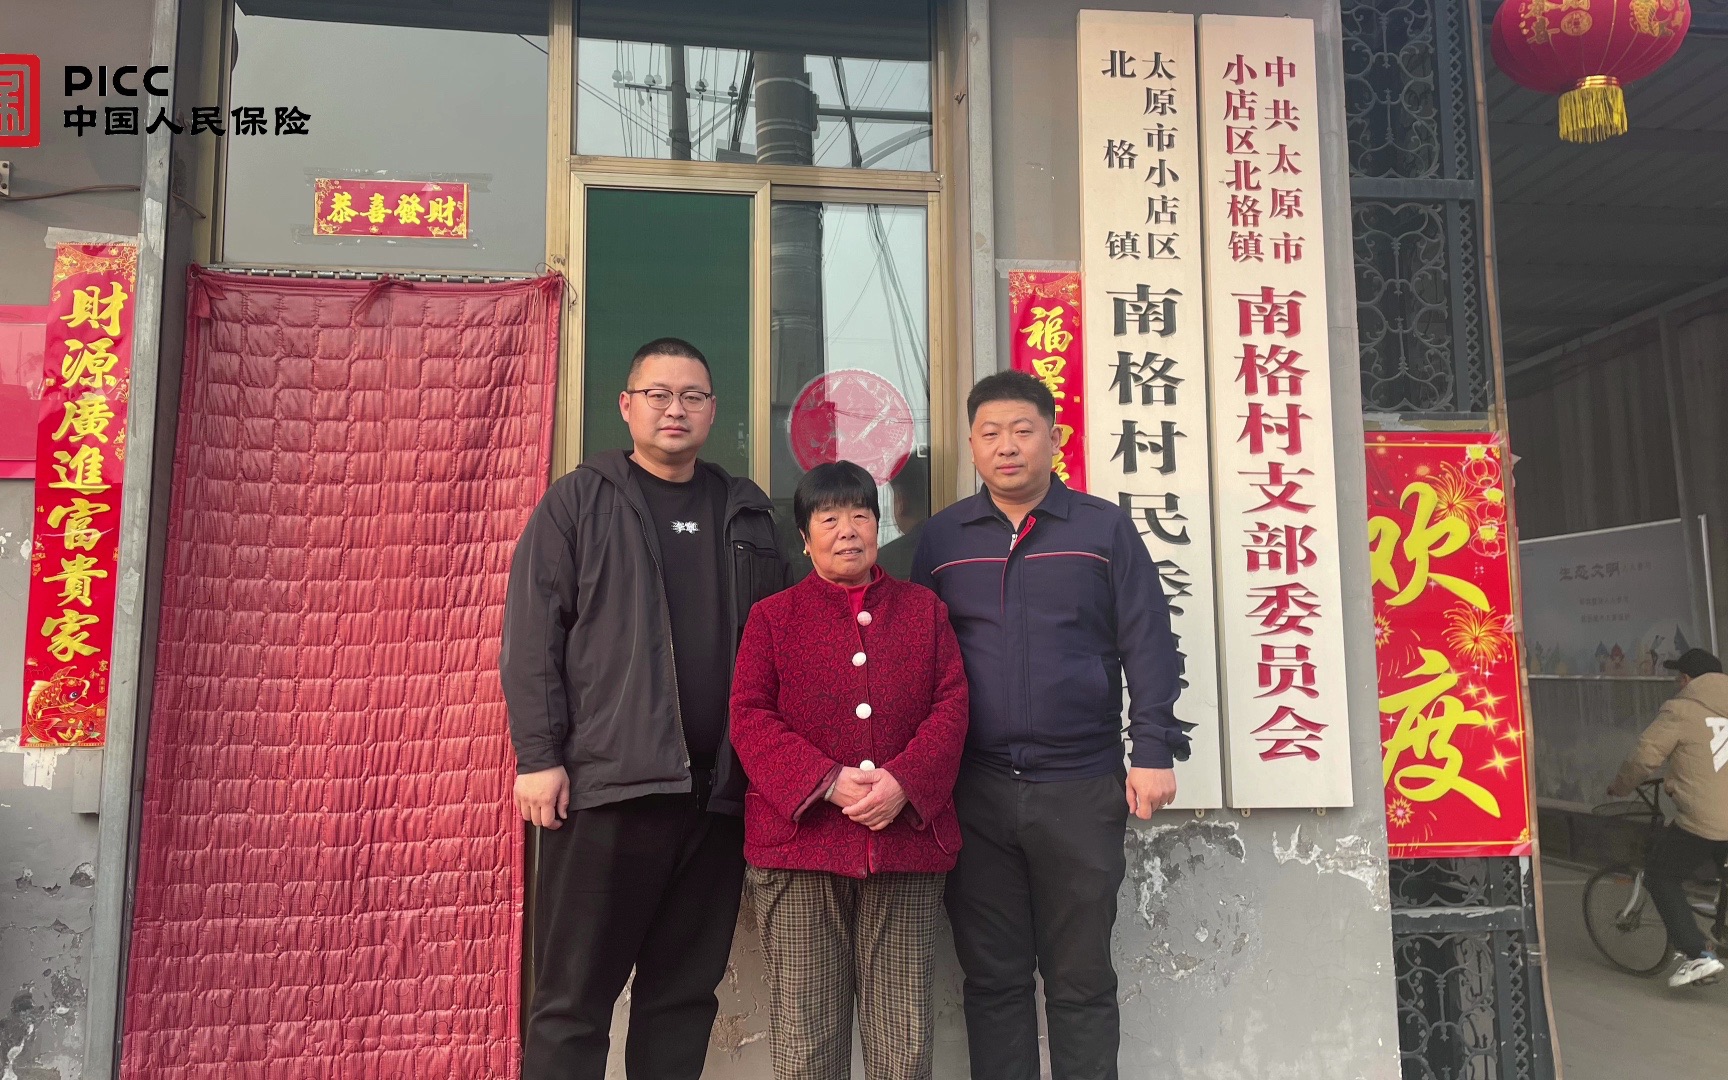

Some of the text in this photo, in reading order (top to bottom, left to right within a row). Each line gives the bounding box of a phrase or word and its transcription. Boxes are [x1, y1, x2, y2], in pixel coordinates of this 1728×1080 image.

[327, 192, 457, 227] 恭喜發財
[1101, 50, 1142, 261] 北格镇
[1142, 52, 1181, 260] 太原市小店区
[1222, 54, 1265, 263] 小店区北格镇
[1265, 56, 1306, 265] 中共太原市
[40, 282, 128, 662] 財源廣進富貴家
[1106, 284, 1199, 762] 南格村民
[1231, 286, 1329, 762] 南格村支部委员会
[1368, 482, 1500, 818] 欢度
